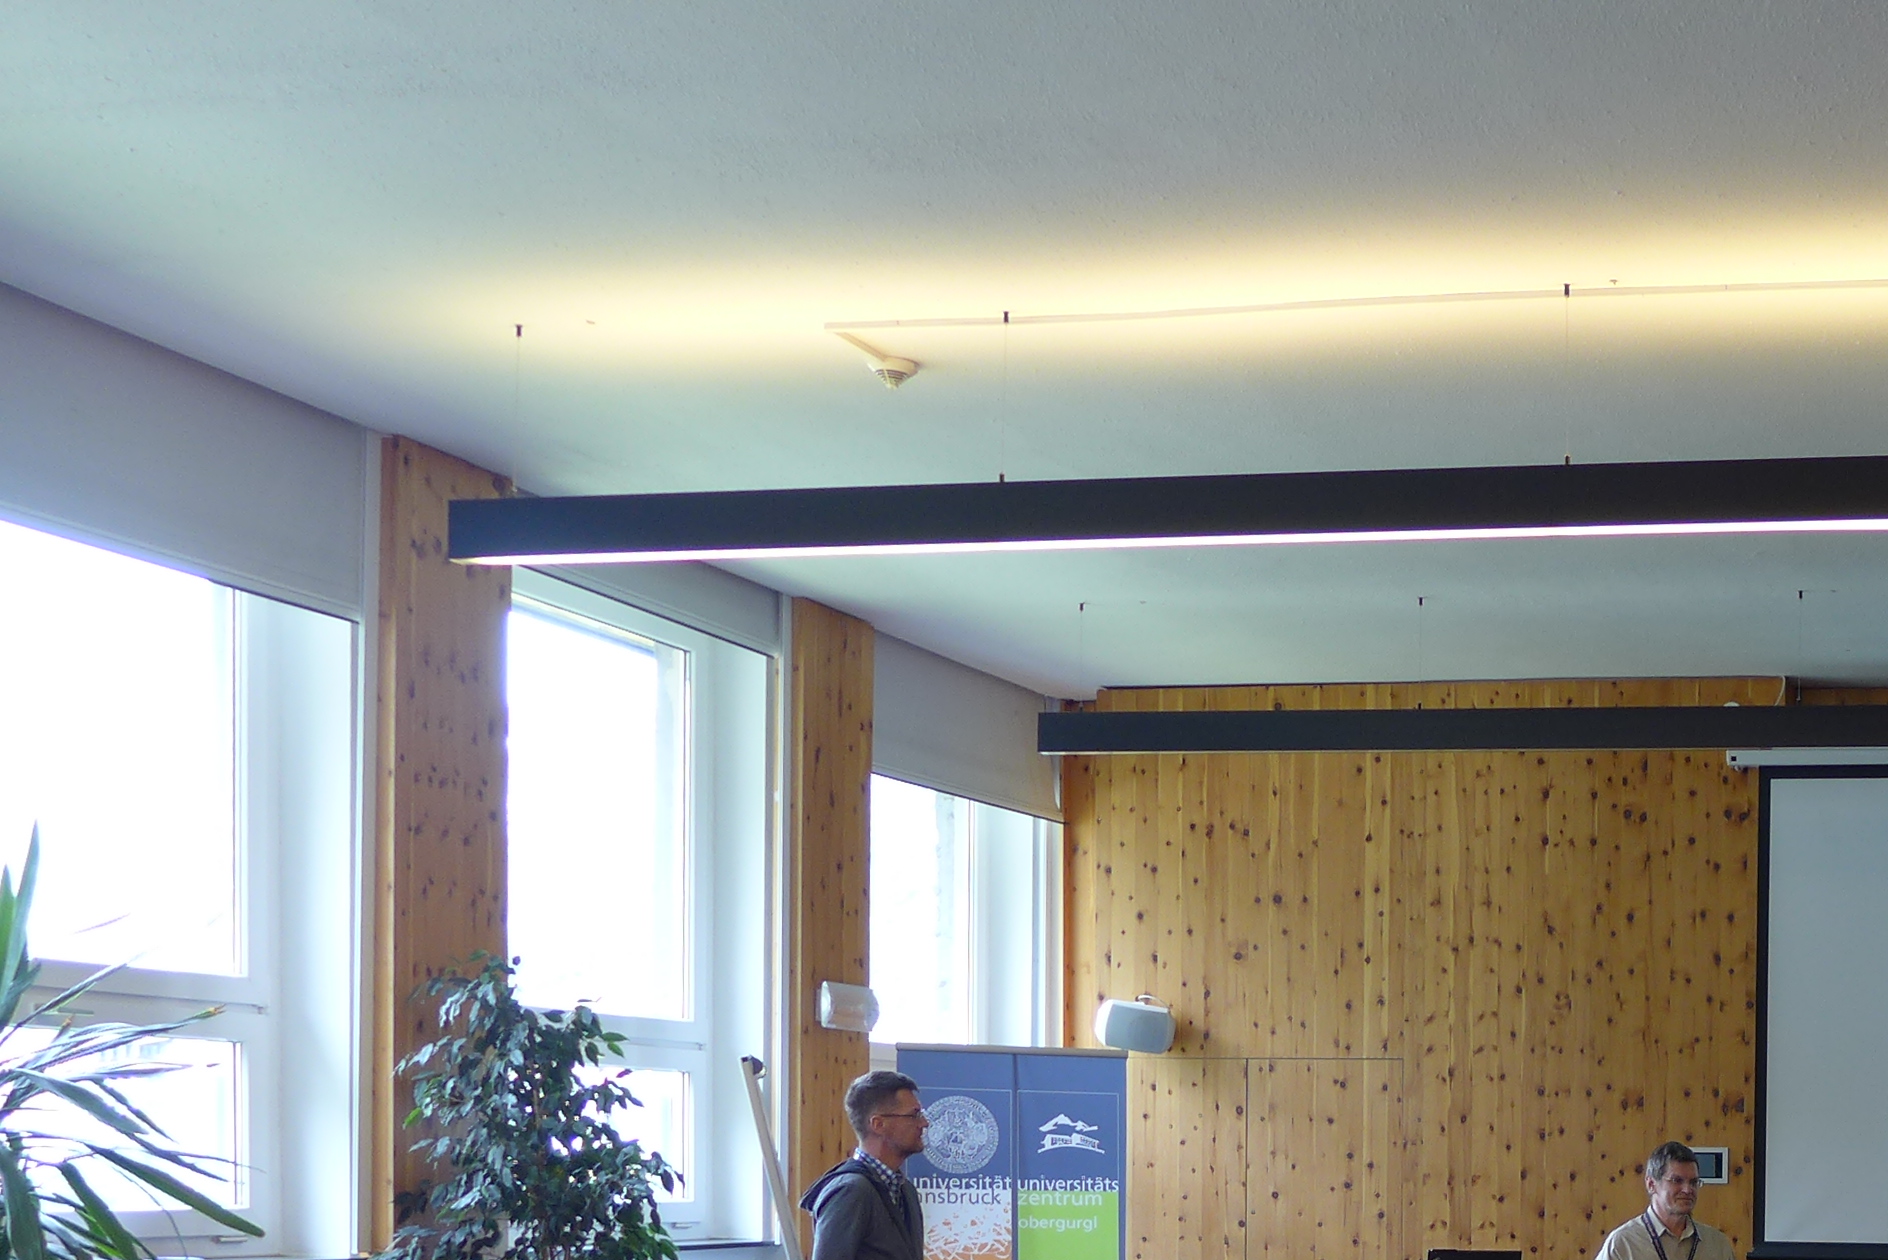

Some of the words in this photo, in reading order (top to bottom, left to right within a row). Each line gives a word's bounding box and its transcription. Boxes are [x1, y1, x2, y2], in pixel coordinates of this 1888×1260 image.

[1017, 1175, 1119, 1192] universitäts
[917, 1189, 1001, 1204] nsbruck
[1018, 1192, 1102, 1206] zentrum
[1018, 1216, 1097, 1232] obergurgl
